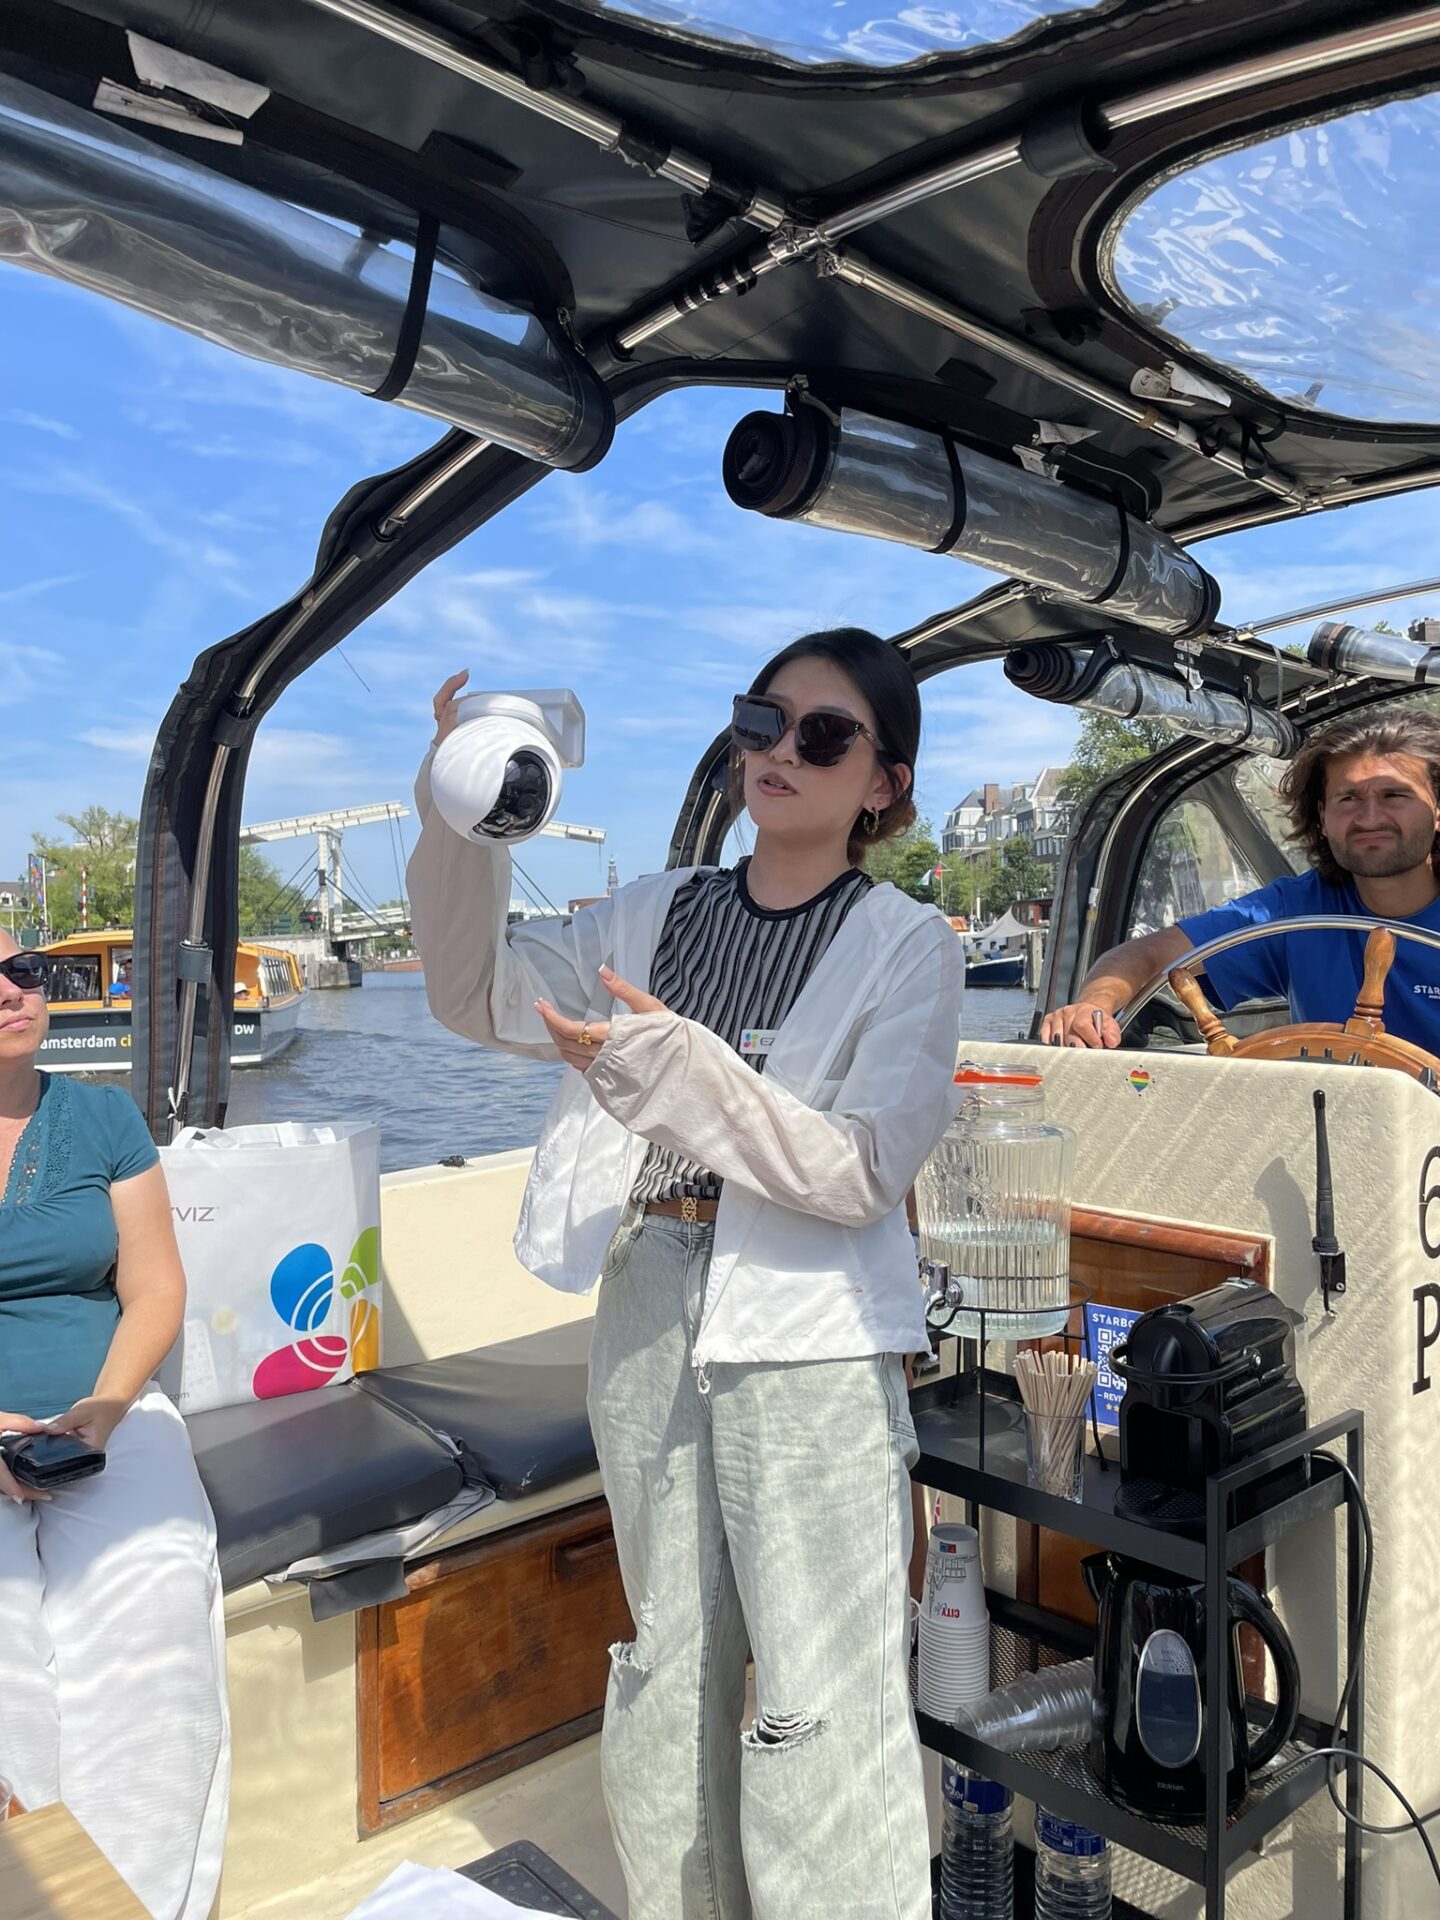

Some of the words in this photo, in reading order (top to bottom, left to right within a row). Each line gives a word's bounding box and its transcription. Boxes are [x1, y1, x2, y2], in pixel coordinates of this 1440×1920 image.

[40, 1035, 117, 1050] amsterdam
[171, 1206, 215, 1222] VIZ
[941, 1606, 960, 1618] CITY
